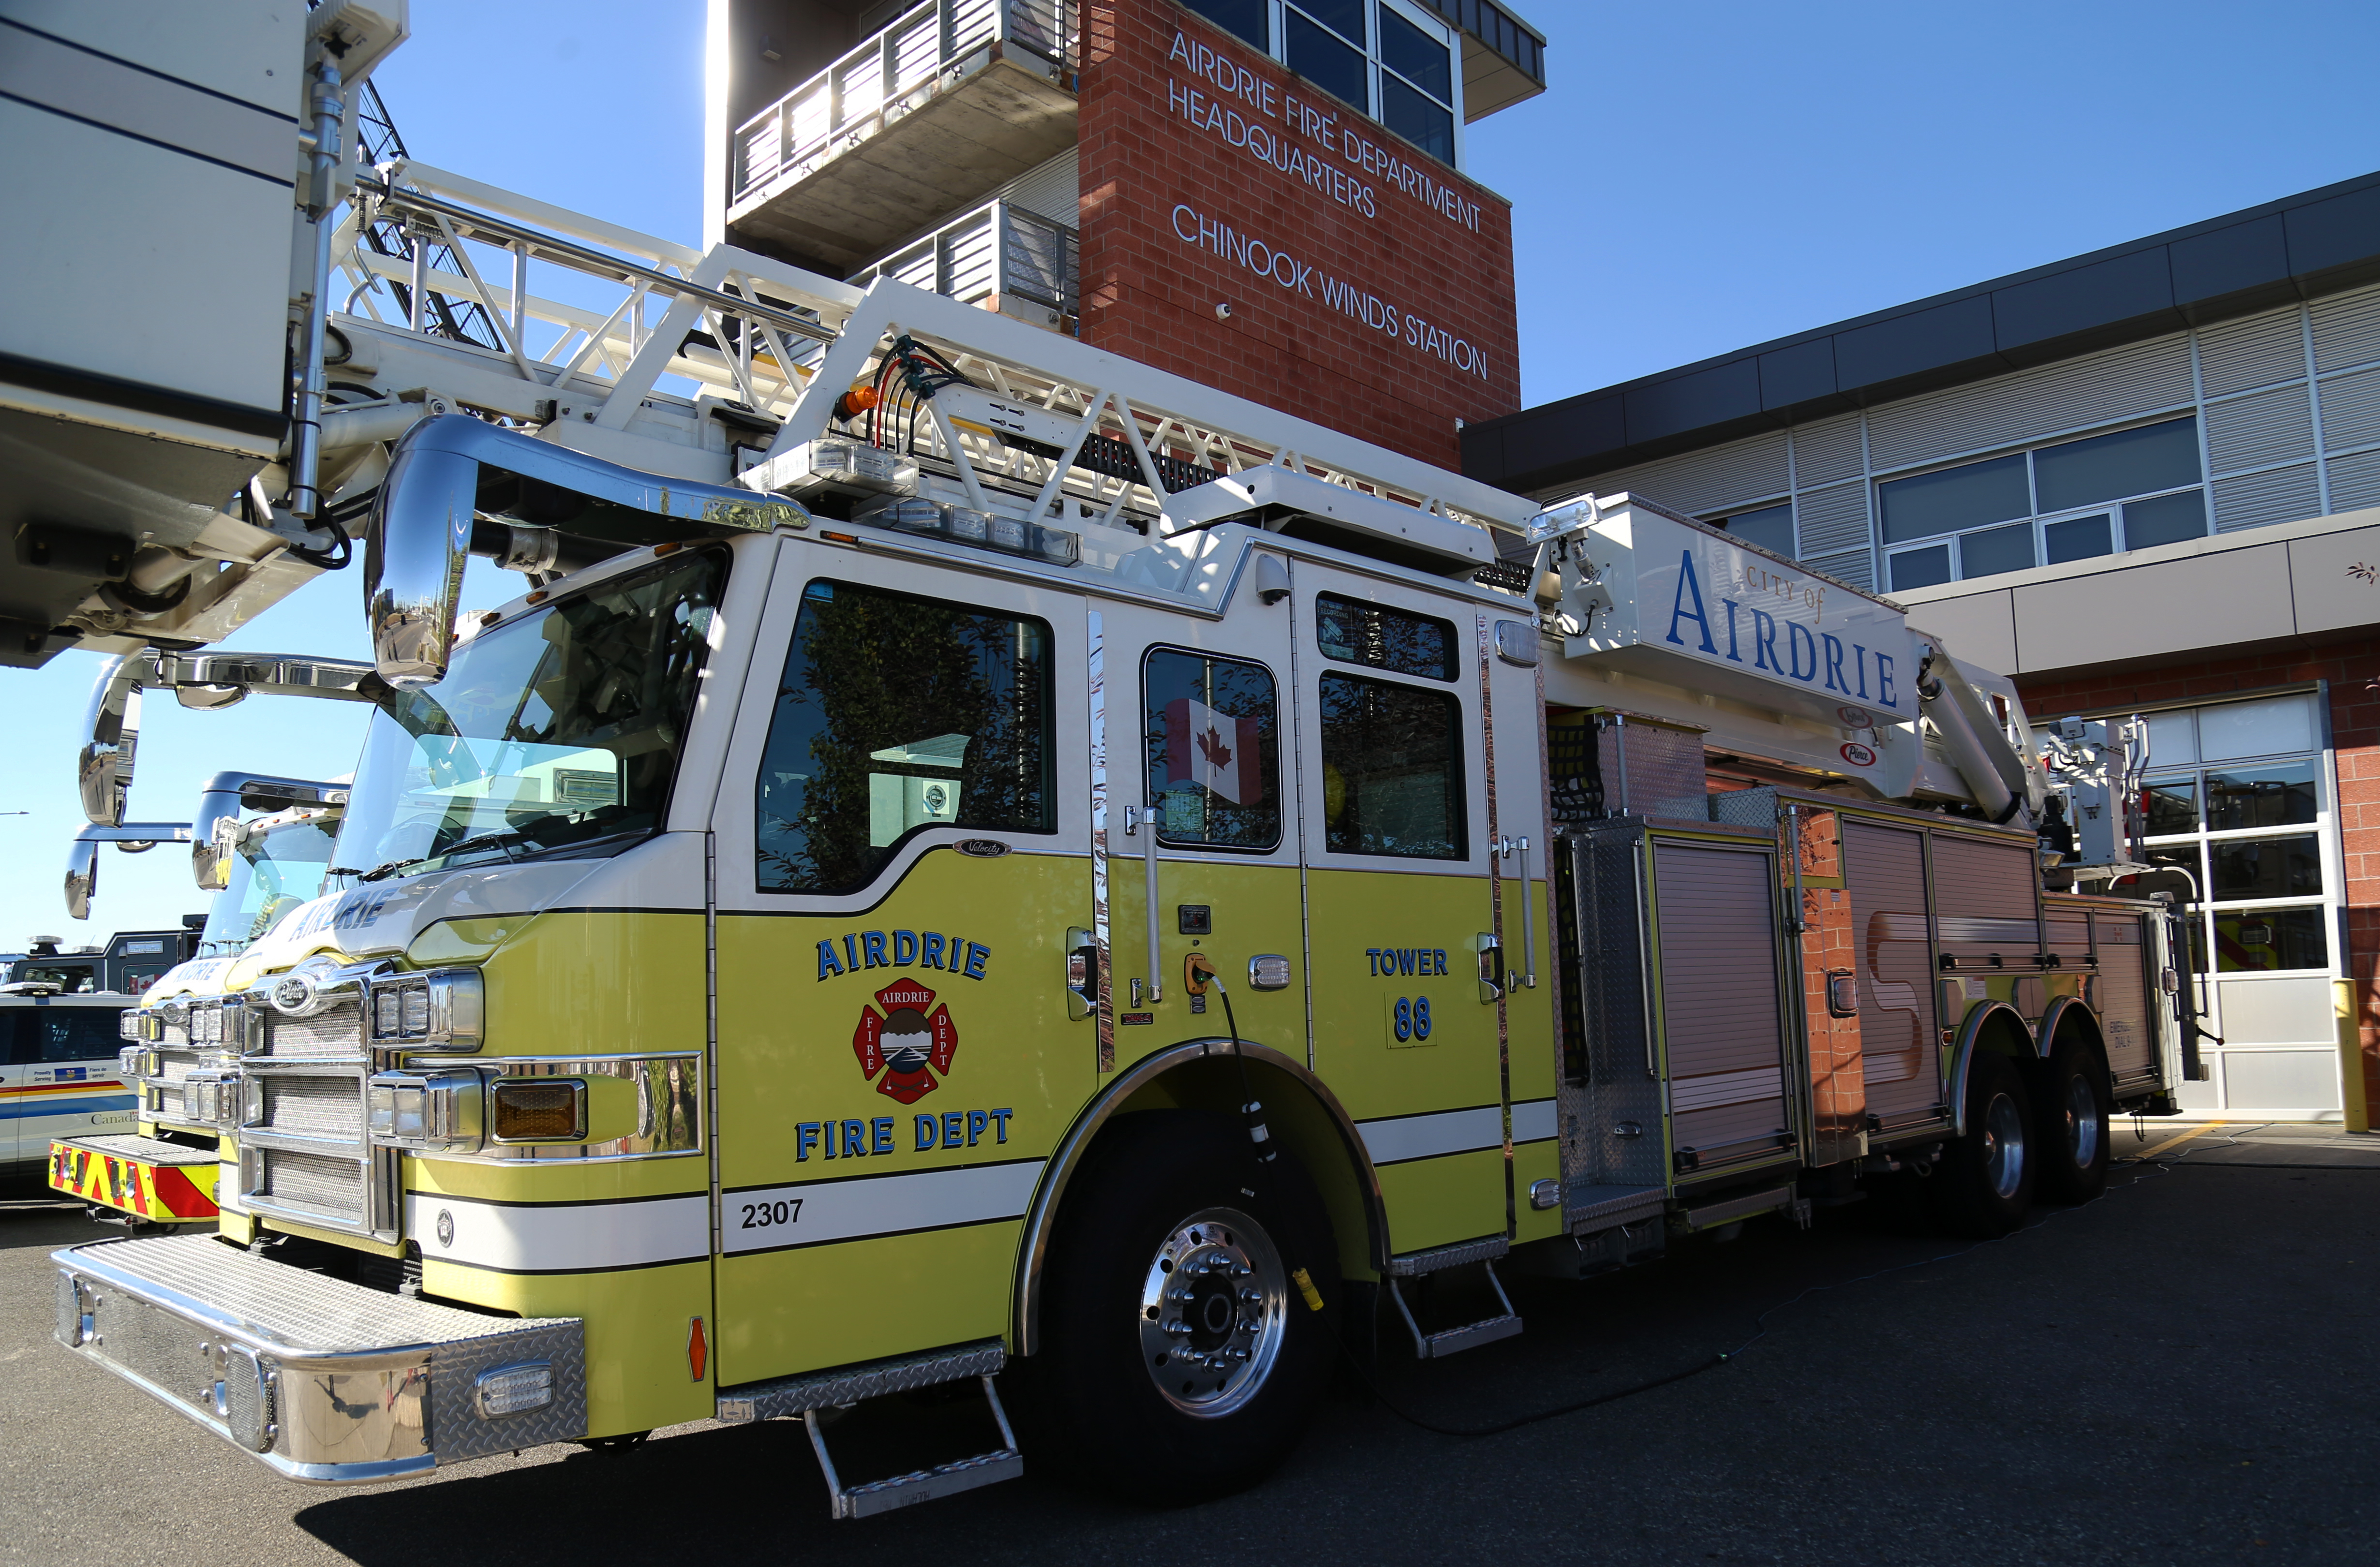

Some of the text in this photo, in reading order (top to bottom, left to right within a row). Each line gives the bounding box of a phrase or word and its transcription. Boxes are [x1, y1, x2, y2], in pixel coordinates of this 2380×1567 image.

[1169, 32, 1481, 234] AIRDRIE FIRE DEPARTMENT
[1169, 78, 1376, 219] HEADQUARTERS
[1173, 205, 1487, 381] CHINOOK WINDS STATION
[1746, 566, 1794, 601] CITY
[1320, 607, 1349, 619] RECORDING
[1666, 550, 1897, 708] AIRDRIE
[1849, 745, 1869, 761] Pierce
[969, 842, 1000, 855] Velocity
[288, 887, 401, 942] AIRDRIE
[816, 930, 991, 982] AIRDRIE
[1365, 948, 1449, 976] TOWER
[882, 991, 929, 1004] AIRDRIE
[1394, 995, 1432, 1043] 88
[866, 1017, 875, 1070] FIRE
[938, 1015, 947, 1066] DEPT
[91, 1112, 139, 1125] Canada
[795, 1108, 1013, 1163] FIRE DEPT
[742, 1198, 803, 1229] 2307
